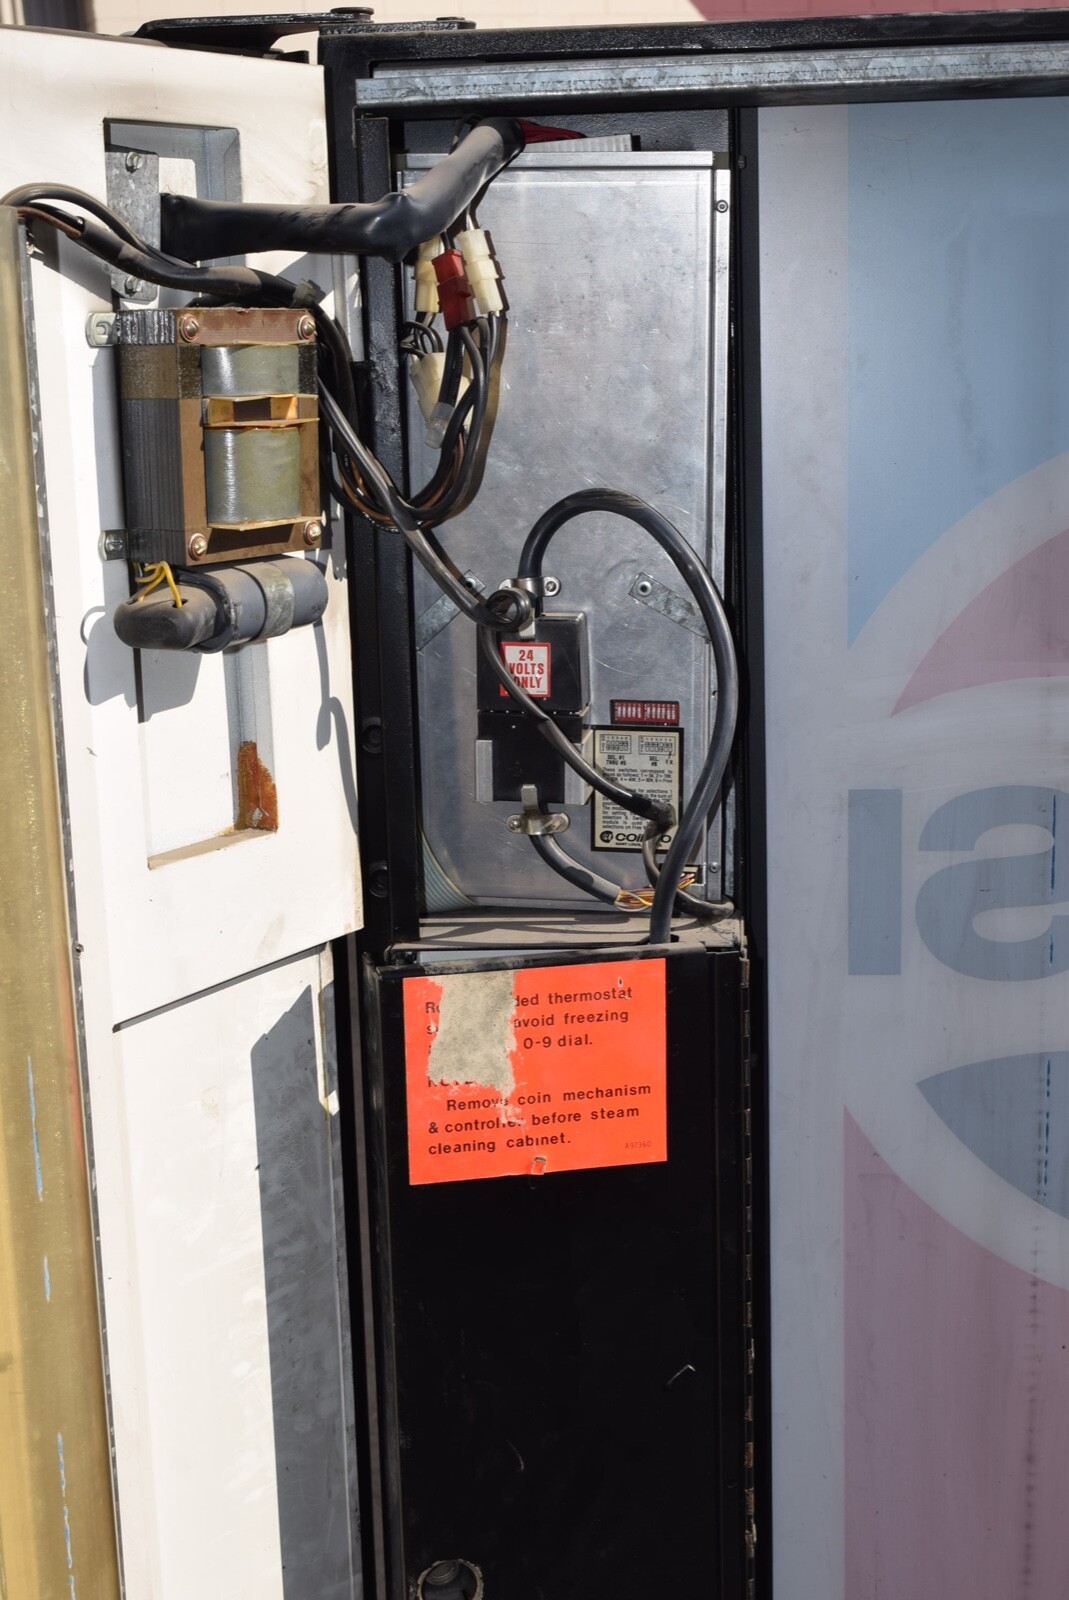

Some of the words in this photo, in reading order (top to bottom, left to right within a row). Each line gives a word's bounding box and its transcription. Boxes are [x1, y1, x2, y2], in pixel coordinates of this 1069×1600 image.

[518, 649, 534, 661] 24
[509, 663, 545, 675] VOLTS
[513, 676, 542, 688] ONLY
[548, 987, 633, 1005] thermostat
[513, 1016, 555, 1029] avoid
[564, 1010, 629, 1026] freezing
[523, 1037, 552, 1050] 0-9
[557, 1034, 593, 1047] dial.
[518, 1093, 552, 1106] coin
[562, 1083, 652, 1102] mechanism
[428, 1121, 439, 1134] &
[531, 1111, 582, 1125] before
[590, 1107, 640, 1120] steam
[428, 1138, 497, 1156] cleaning
[506, 1134, 572, 1149] cabinet.
